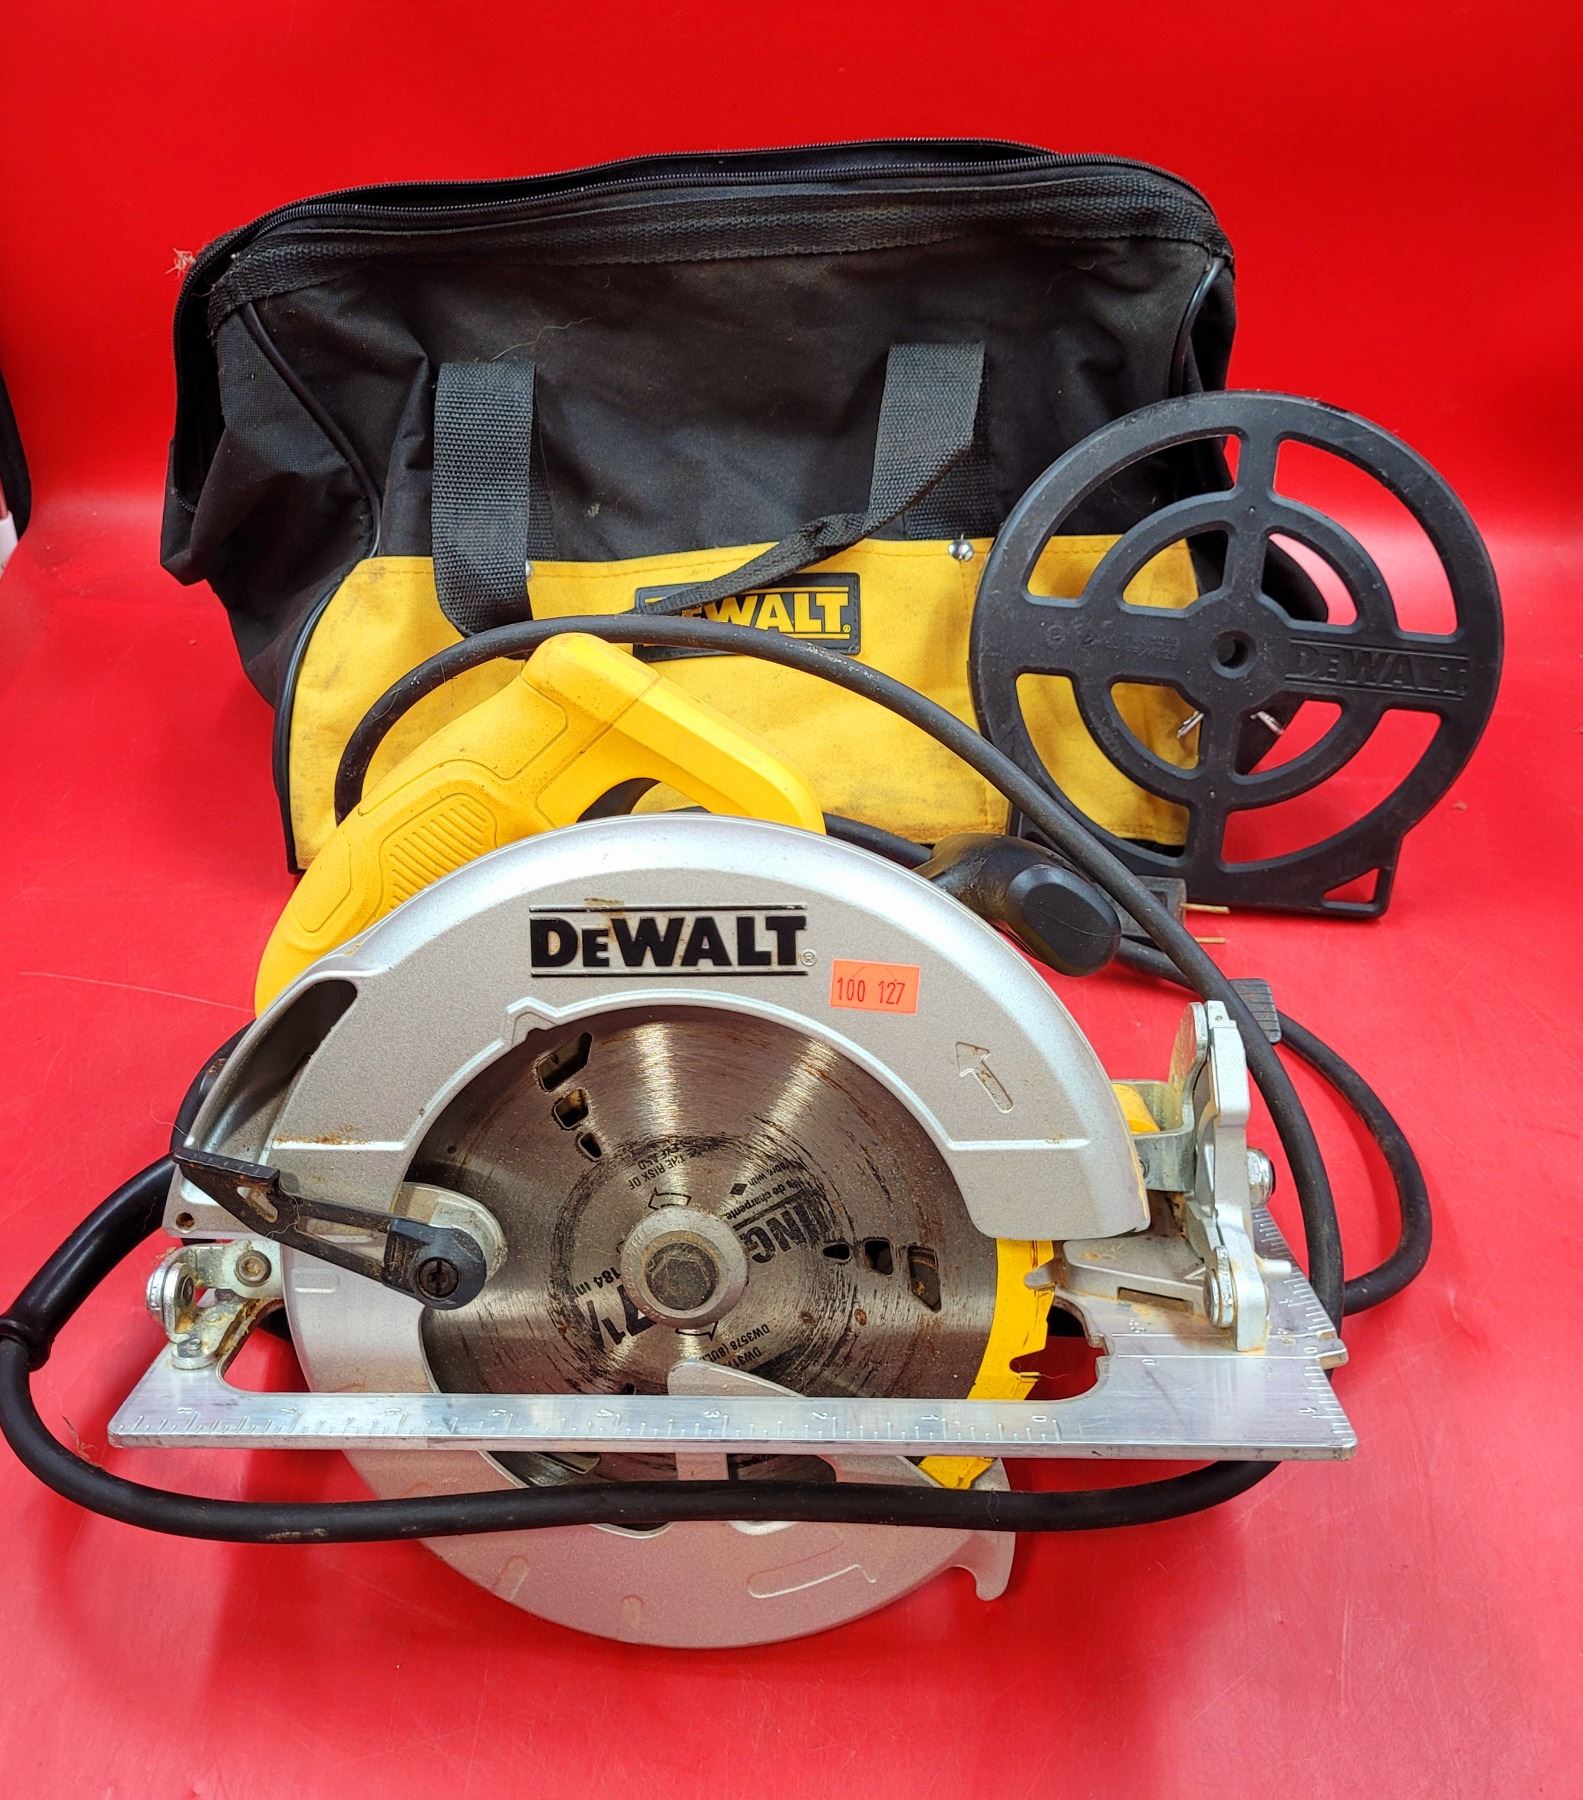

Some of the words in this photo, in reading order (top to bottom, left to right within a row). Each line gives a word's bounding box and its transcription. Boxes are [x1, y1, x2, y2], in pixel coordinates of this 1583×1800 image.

[837, 977, 865, 1003] 100
[878, 980, 906, 1006] 127
[628, 1176, 642, 1190] OF
[641, 1163, 666, 1182] RISK
[725, 1190, 773, 1220] charpente
[593, 1267, 621, 1289] 184
[731, 1323, 770, 1351] DW3578
